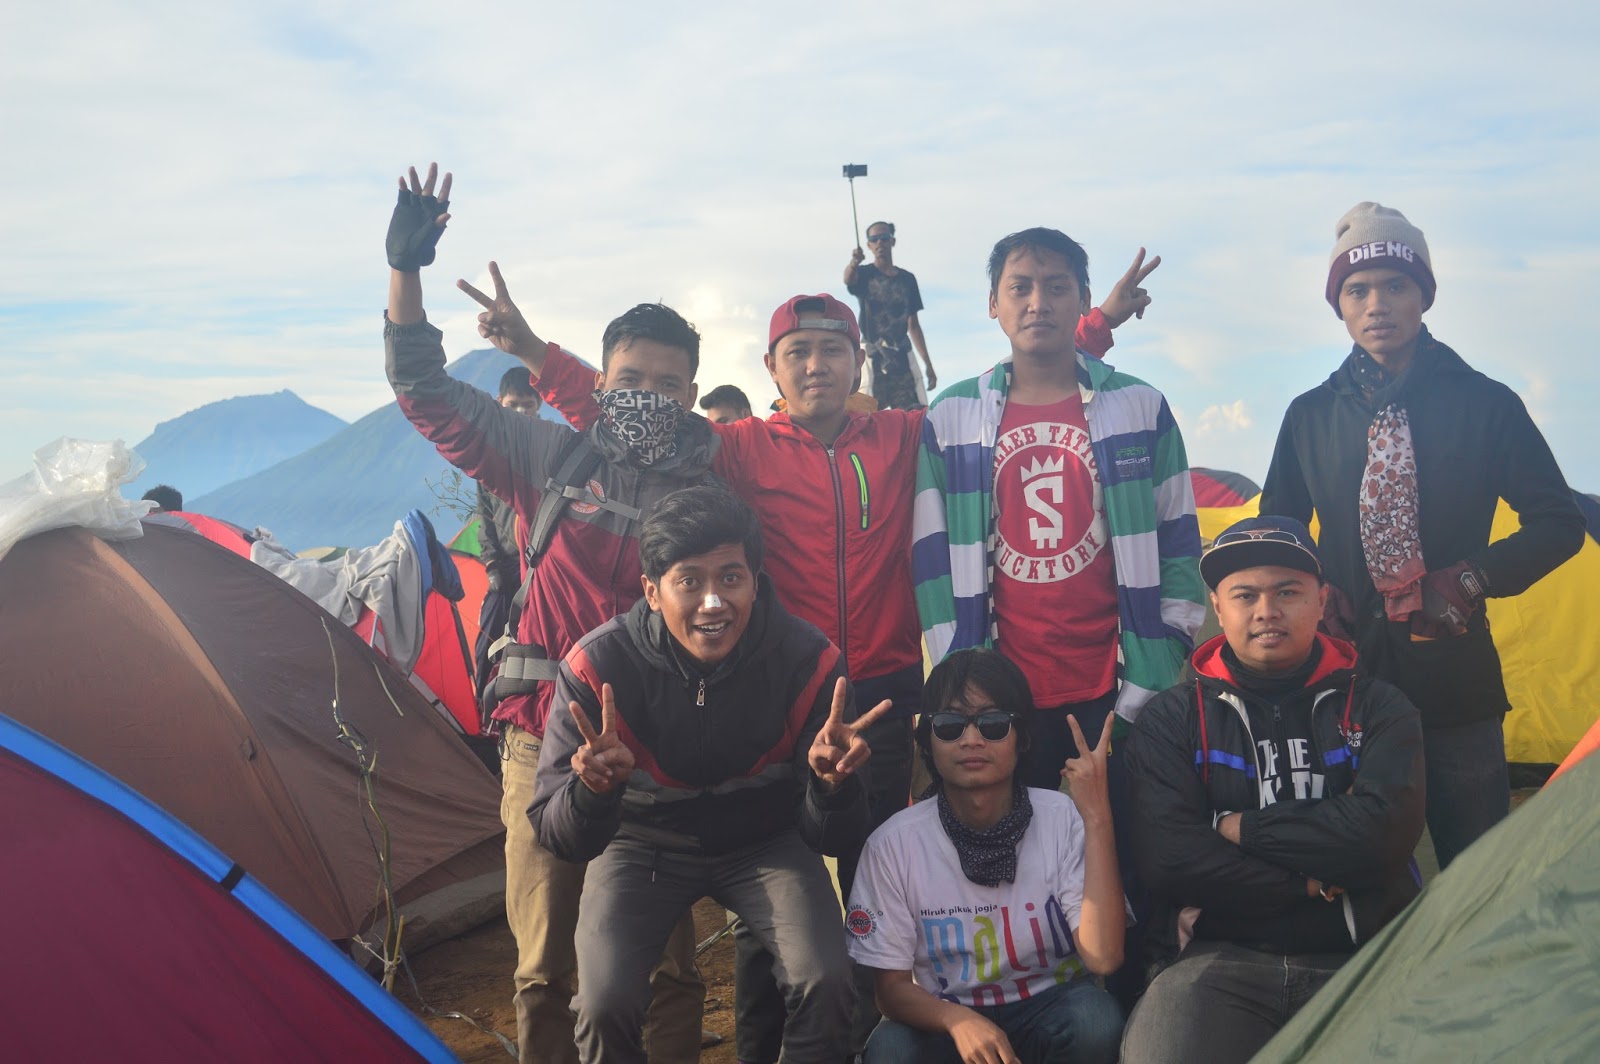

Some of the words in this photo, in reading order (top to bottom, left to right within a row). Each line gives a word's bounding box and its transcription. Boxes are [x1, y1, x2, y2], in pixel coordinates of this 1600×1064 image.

[920, 908, 946, 916] Hiruk
[948, 905, 973, 916] pikuk
[974, 903, 998, 915] jogja
